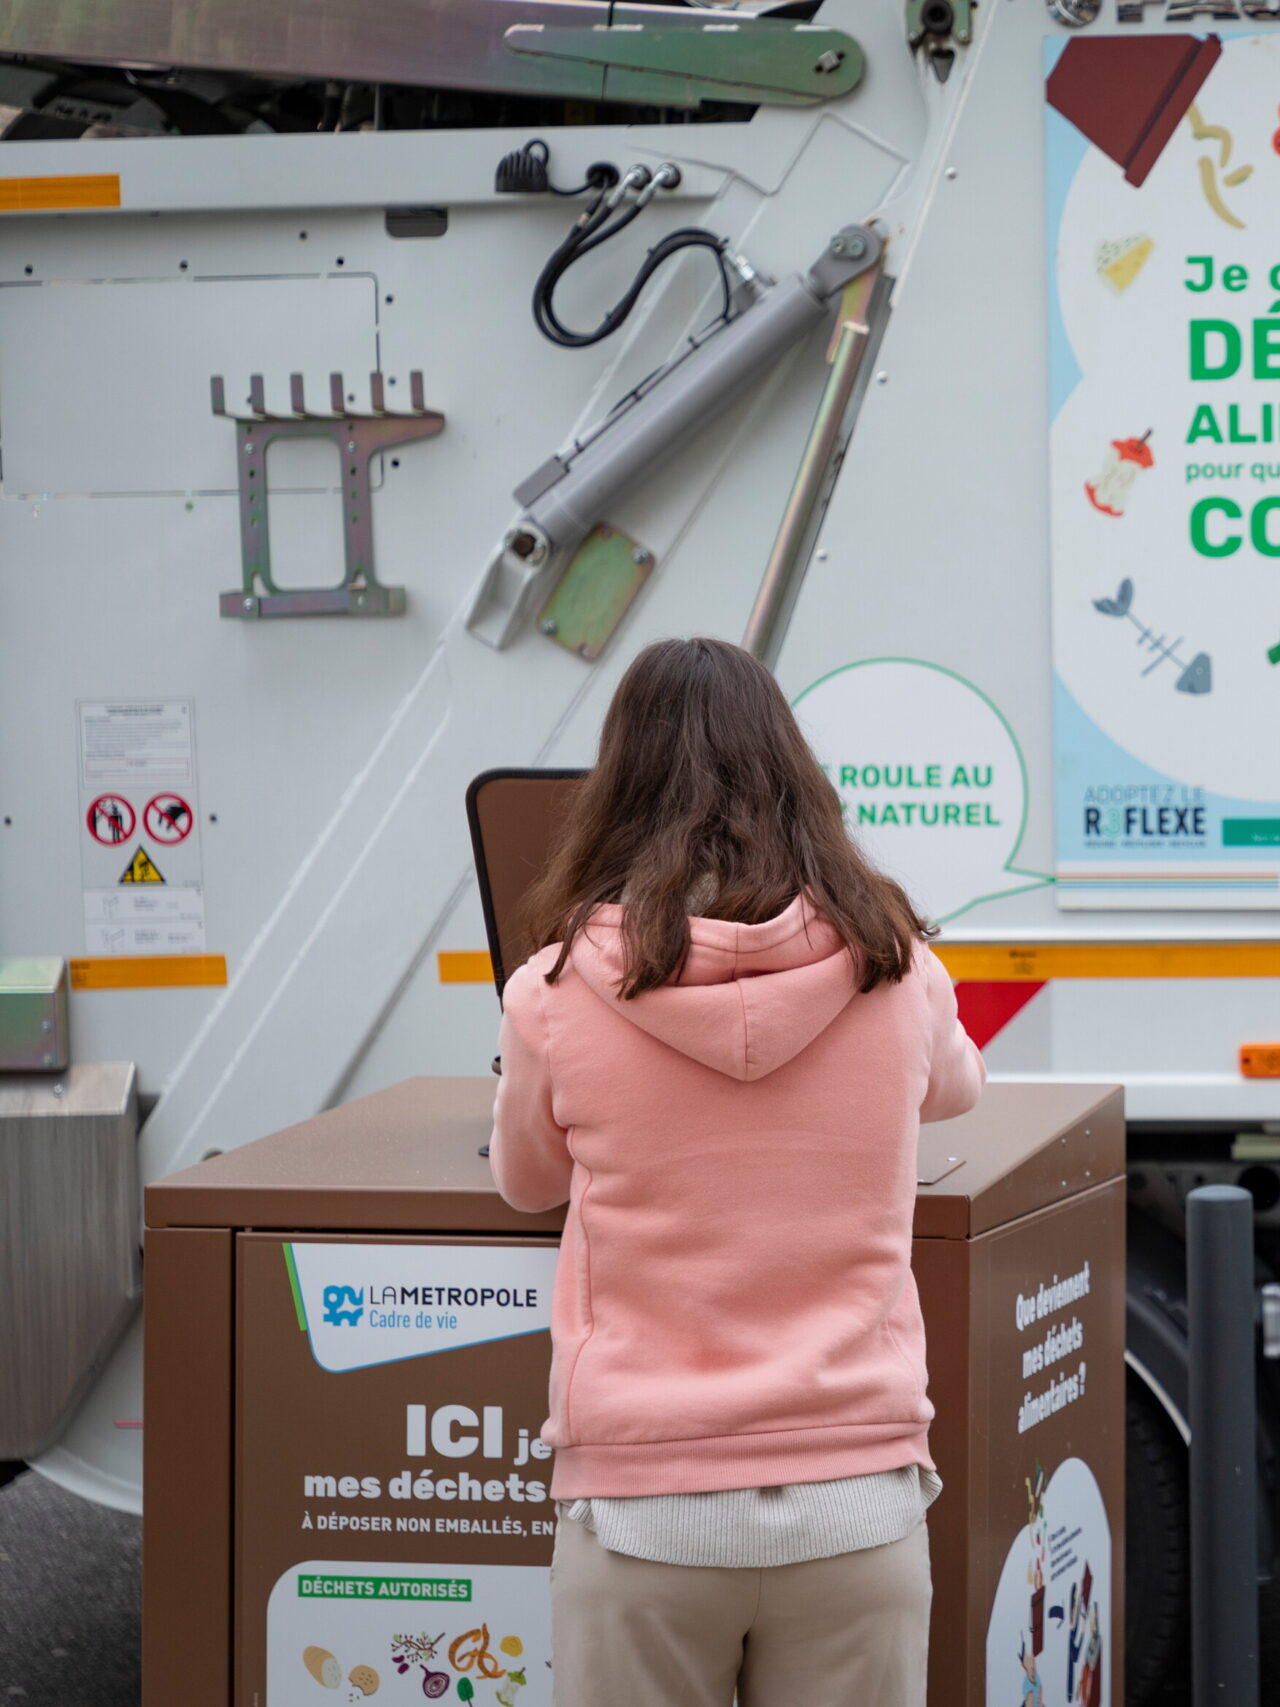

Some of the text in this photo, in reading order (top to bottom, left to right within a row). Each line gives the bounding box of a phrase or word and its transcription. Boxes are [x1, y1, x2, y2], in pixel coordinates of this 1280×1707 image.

[1184, 256, 1249, 293] Je
[1186, 460, 1244, 484] pour
[840, 765, 942, 788] ROULE
[951, 765, 992, 788] AU
[1084, 784, 1205, 803] ADOPTEZ LE
[857, 803, 1001, 826] NATUREL
[1016, 1261, 1090, 1331] Que deviennent
[369, 1309, 457, 1329] Cadre de vie
[1022, 1317, 1083, 1379] mes déchets
[406, 1404, 553, 1466] ICI je
[304, 1469, 547, 1503] mes déchets
[301, 1510, 553, 1537] À DÉPOSER NON EMBALLÉS, EN
[302, 1575, 468, 1598] DÉCHETS AUTORISÉS
